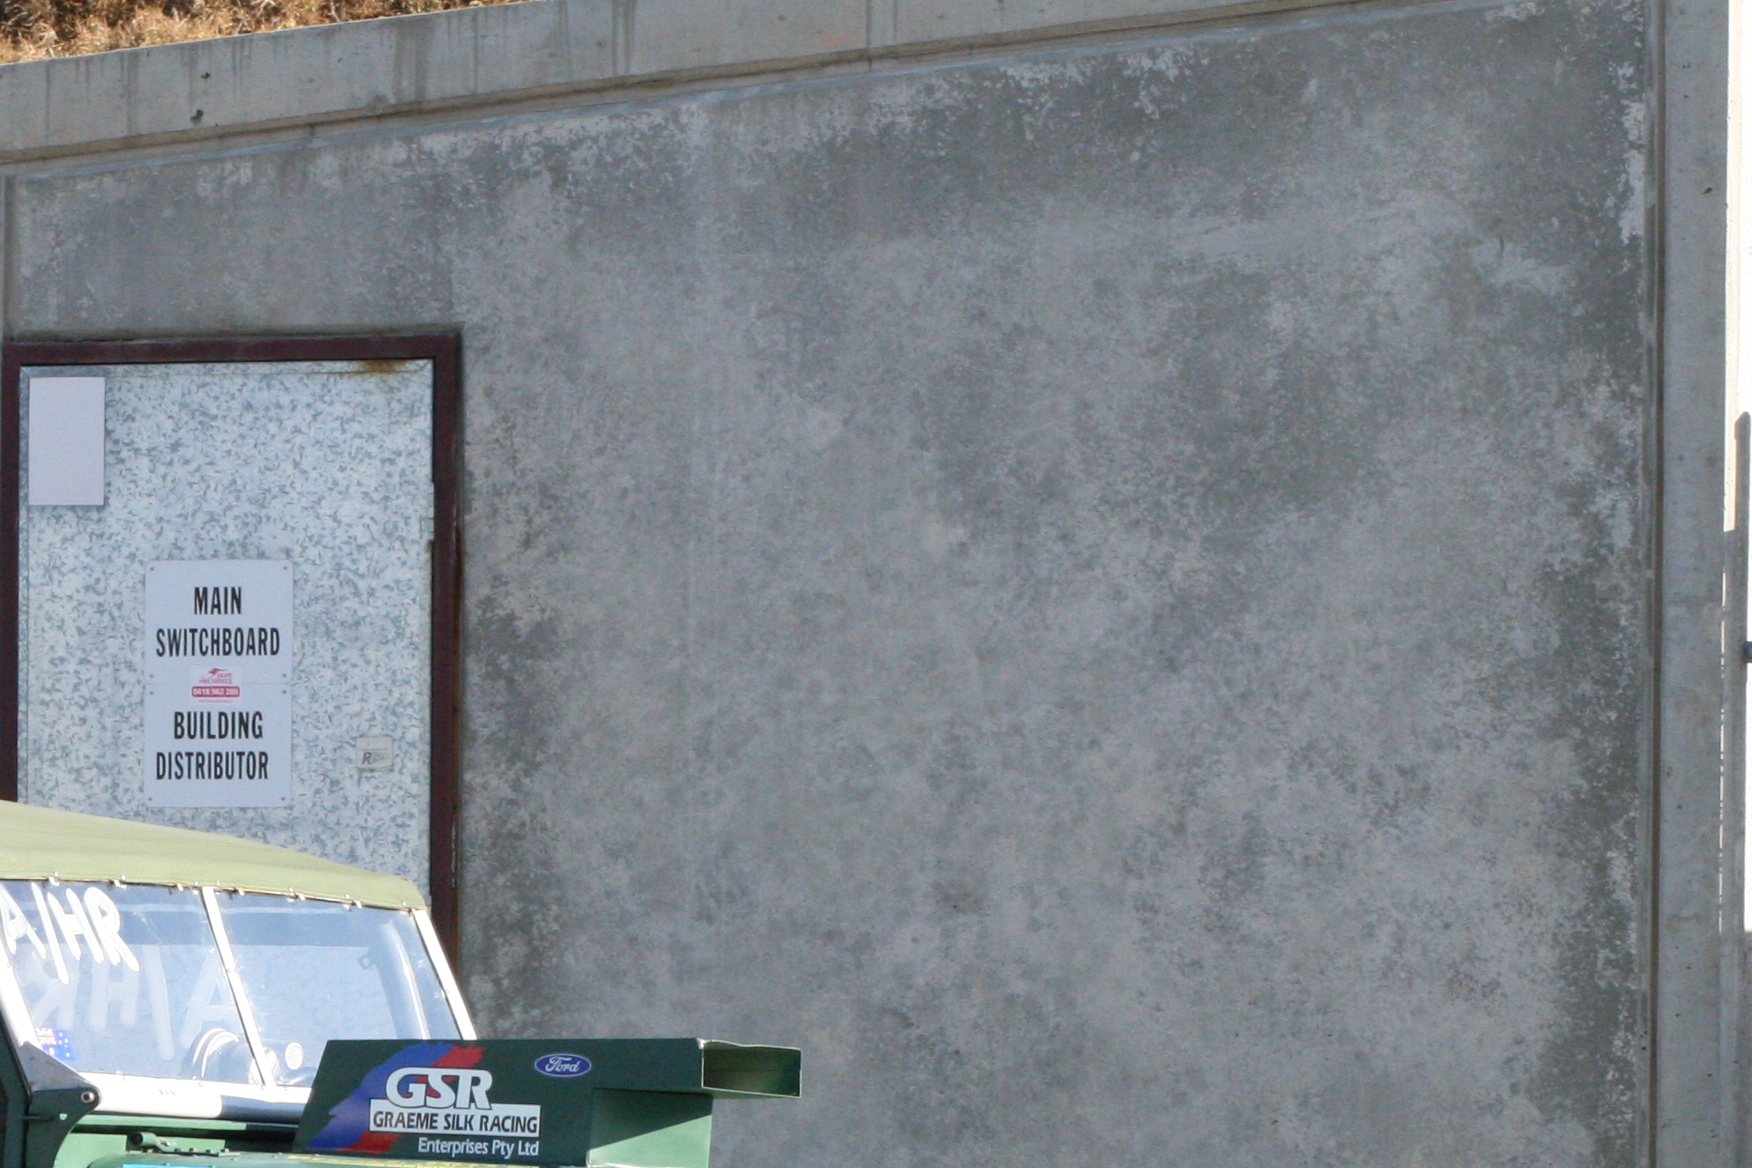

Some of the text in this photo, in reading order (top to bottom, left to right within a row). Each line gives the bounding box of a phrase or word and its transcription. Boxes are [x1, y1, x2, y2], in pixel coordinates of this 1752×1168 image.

[193, 586, 242, 616] MAIN
[155, 628, 281, 657] SWITCHBOARD
[173, 711, 264, 740] BUILDING
[155, 751, 269, 780] DISTRIBUTOR
[545, 1055, 580, 1073] Ford
[385, 1067, 493, 1110] GSR
[373, 1111, 537, 1134] GRAEME SILK RACING
[418, 1137, 539, 1159] Enterprises Pty Ltd
